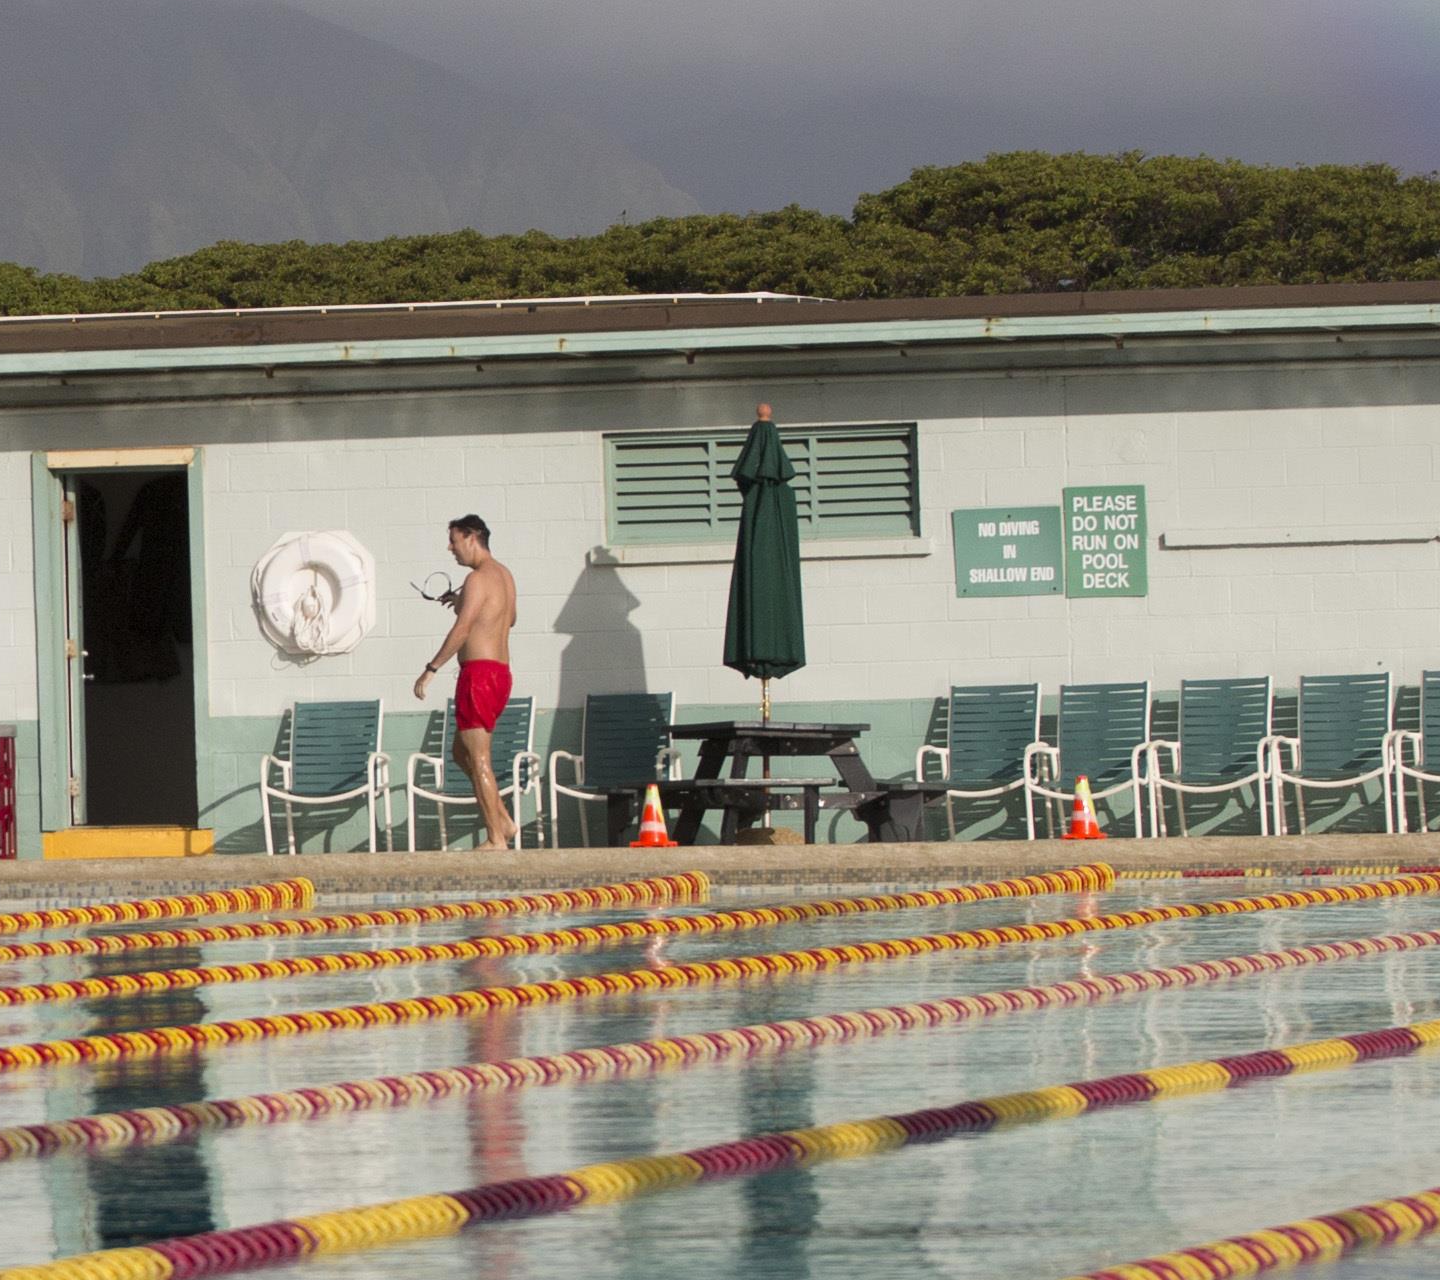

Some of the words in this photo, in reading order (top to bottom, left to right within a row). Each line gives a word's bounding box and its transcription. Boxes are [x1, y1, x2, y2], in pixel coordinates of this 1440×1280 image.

[1072, 495, 1137, 512] PLEASE
[978, 522, 996, 537] NO
[999, 521, 1039, 536] DIVING
[1072, 516, 1097, 531] DO
[1104, 514, 1138, 531] NOT
[1072, 534, 1107, 551] RUN
[1114, 534, 1139, 550] ON
[1003, 544, 1016, 559] IN
[1082, 554, 1128, 569] POOL
[970, 567, 1027, 583] SHALLOW
[1031, 567, 1054, 581] END
[1083, 573, 1129, 589] DECK
